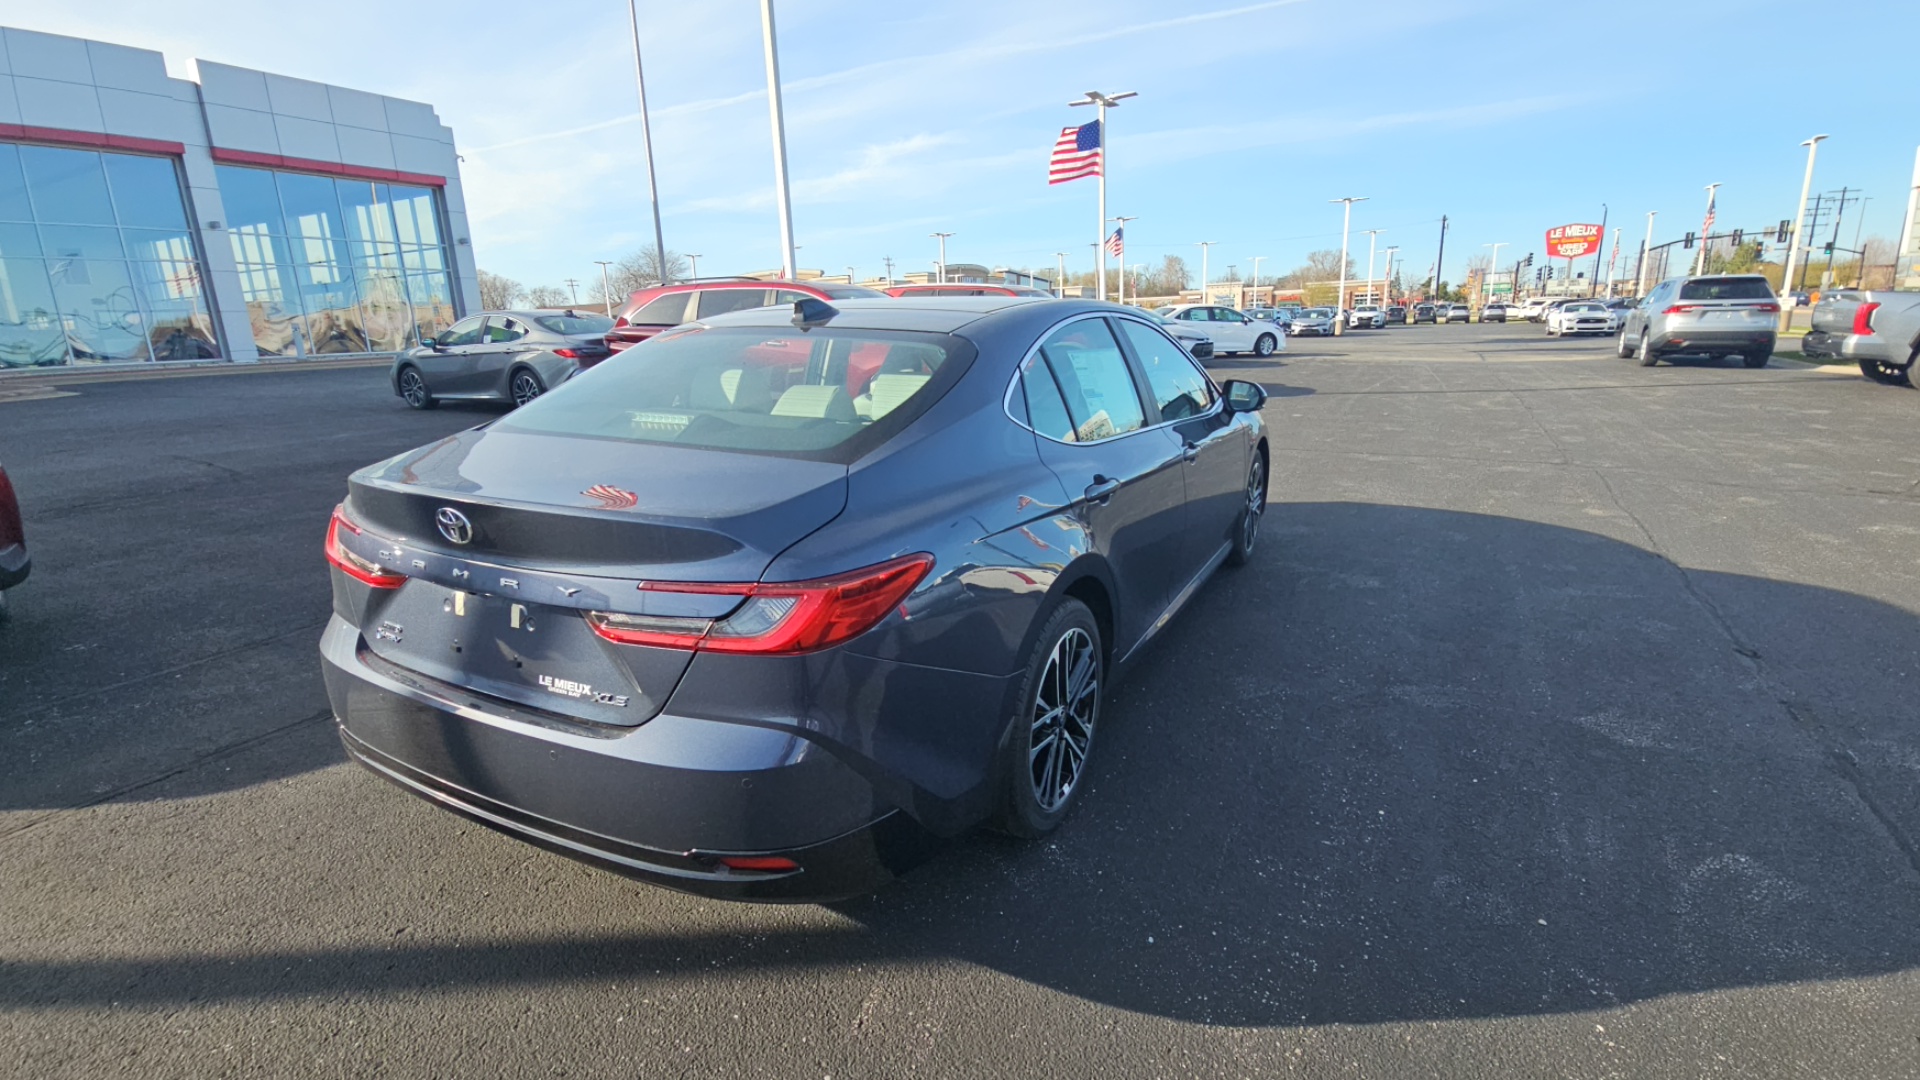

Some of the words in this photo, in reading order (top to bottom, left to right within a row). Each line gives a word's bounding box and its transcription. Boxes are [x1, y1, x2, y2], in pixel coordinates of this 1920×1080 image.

[1550, 228, 1563, 238] LE
[1565, 225, 1598, 238] MIEUX
[1557, 242, 1588, 251] USED
[1560, 248, 1585, 256] CARS
[379, 550, 583, 597] CAMRY
[538, 674, 553, 686] LE
[554, 678, 592, 695] MIEUX
[590, 691, 630, 707] XLE
